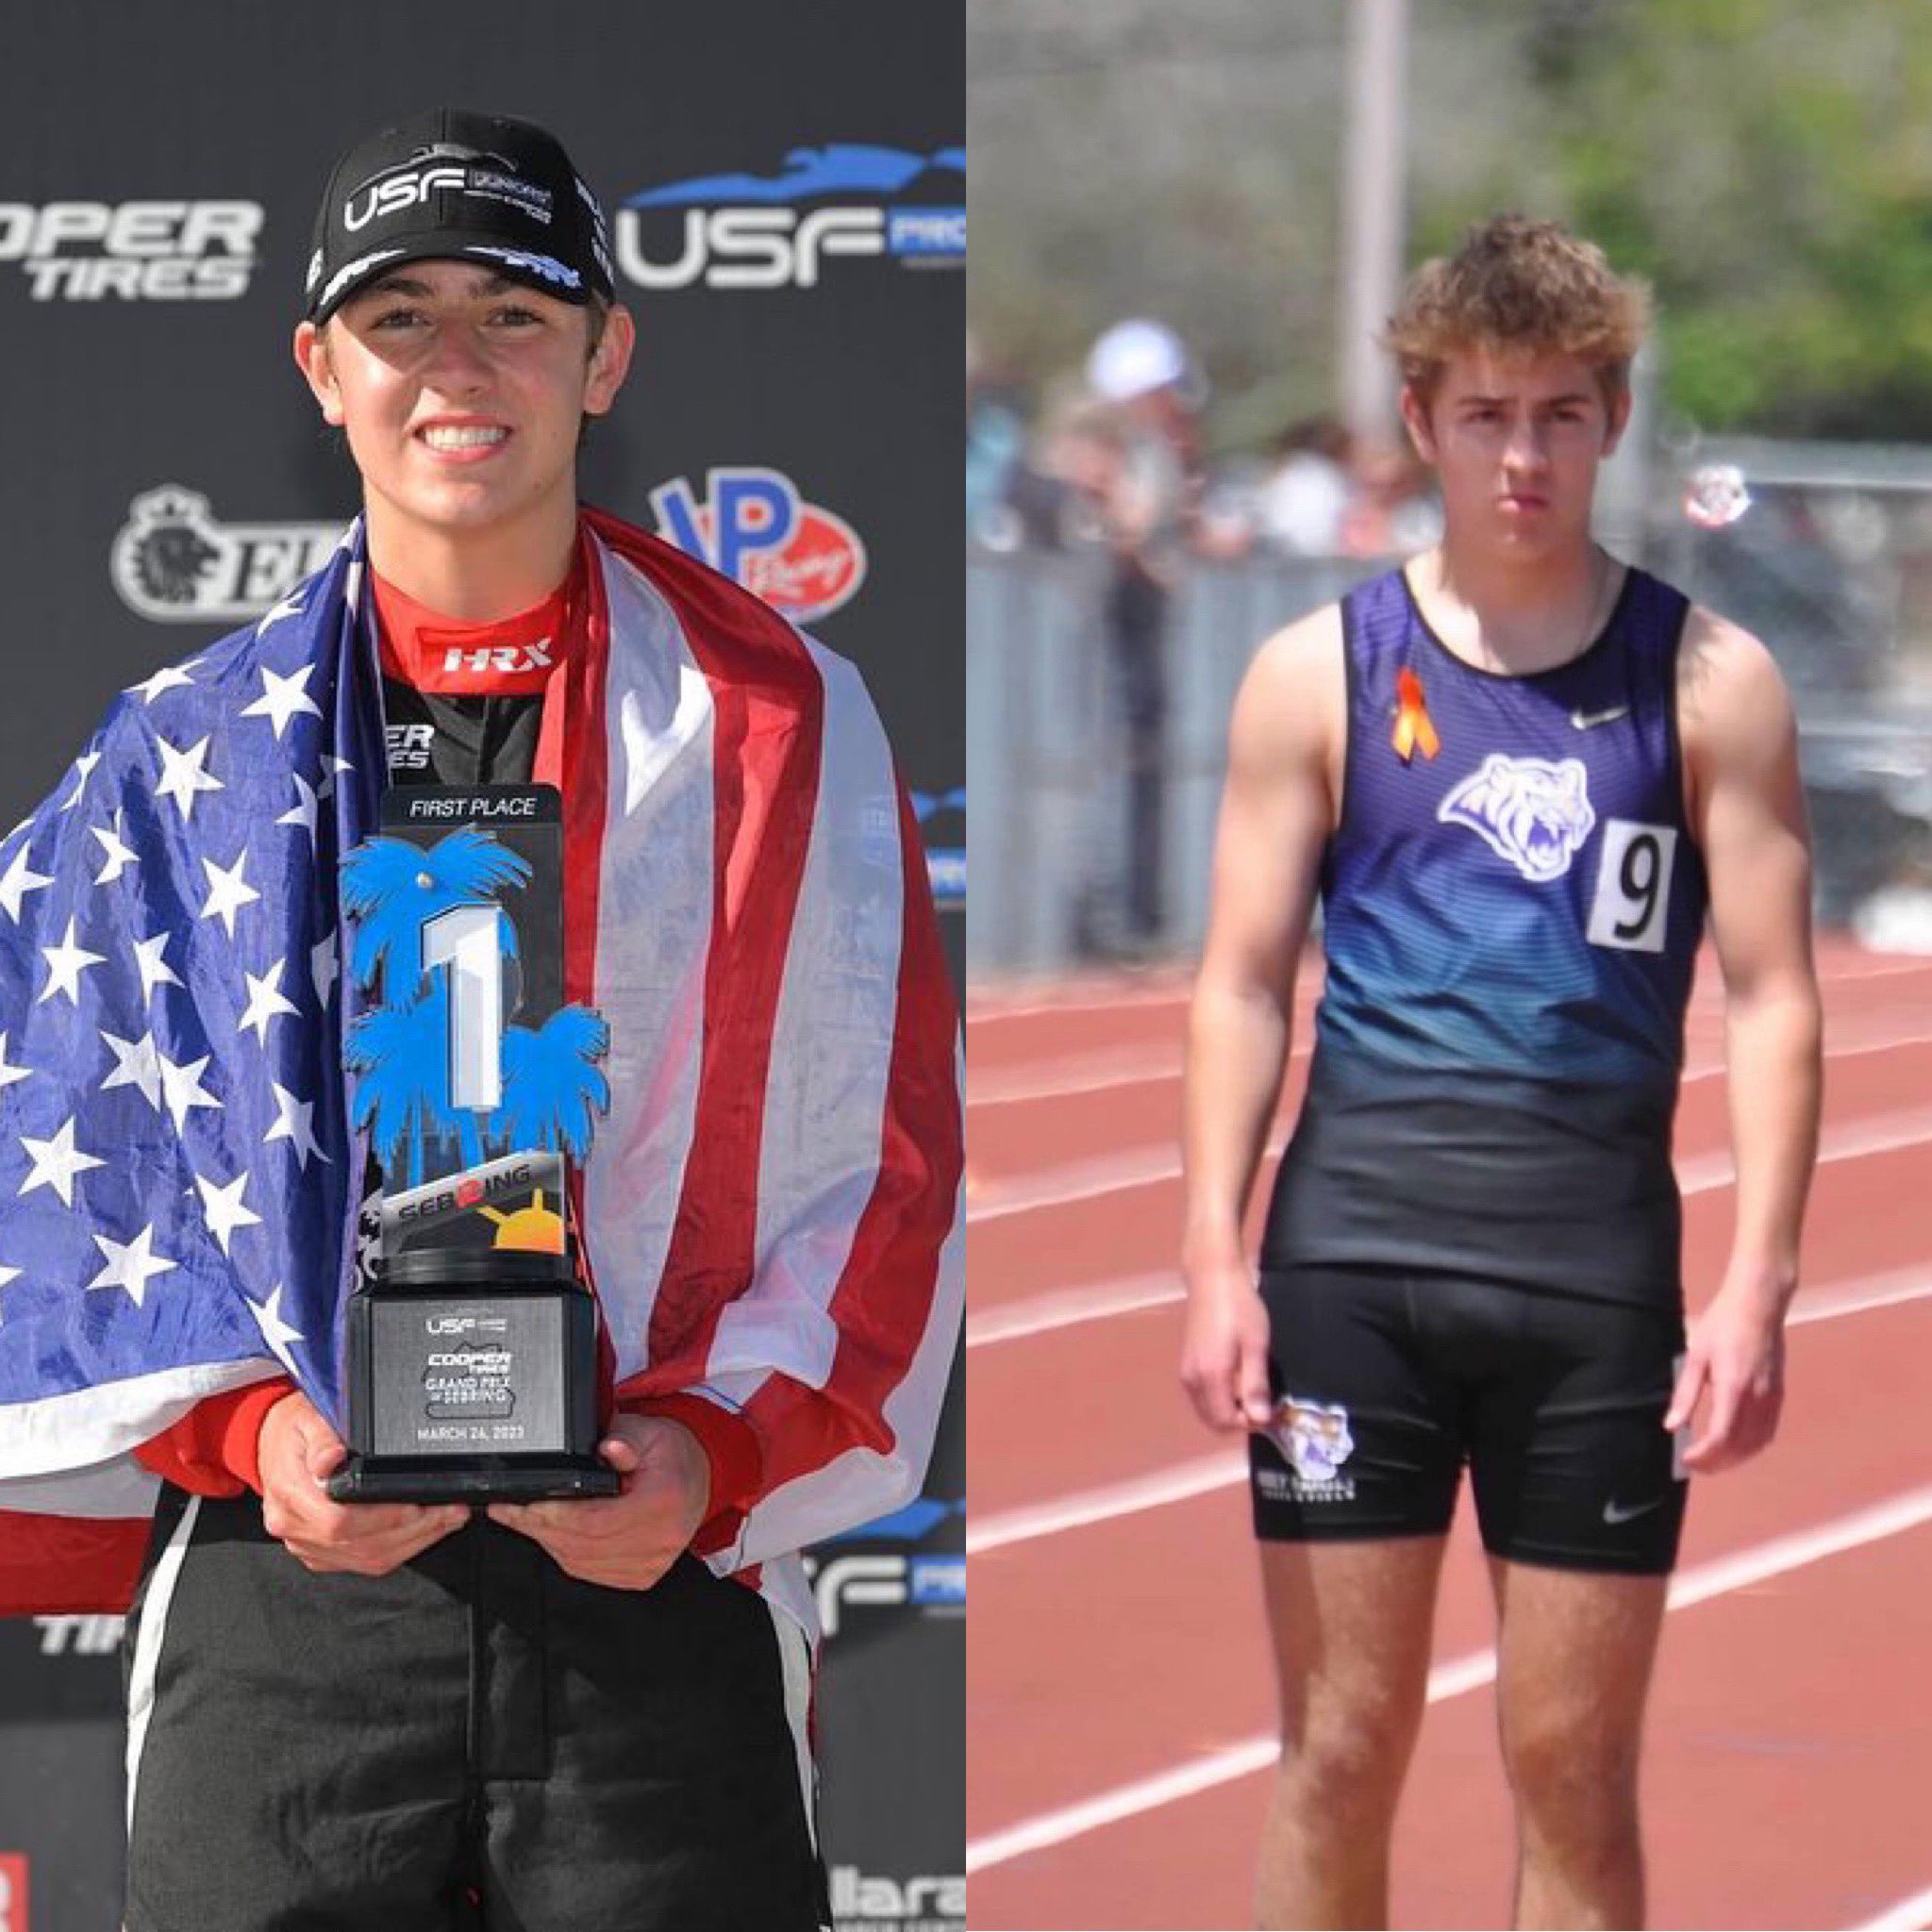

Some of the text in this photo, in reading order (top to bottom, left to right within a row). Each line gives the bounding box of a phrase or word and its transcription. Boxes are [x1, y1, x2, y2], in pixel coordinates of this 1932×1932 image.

[343, 168, 465, 232] USF
[23, 257, 253, 301] TIRES
[615, 207, 885, 290] USF
[442, 638, 551, 672] HRX
[409, 798, 538, 818] FIRST PLACE
[1613, 834, 1660, 941] 9
[421, 901, 503, 1111] 1
[803, 1557, 908, 1637] F
